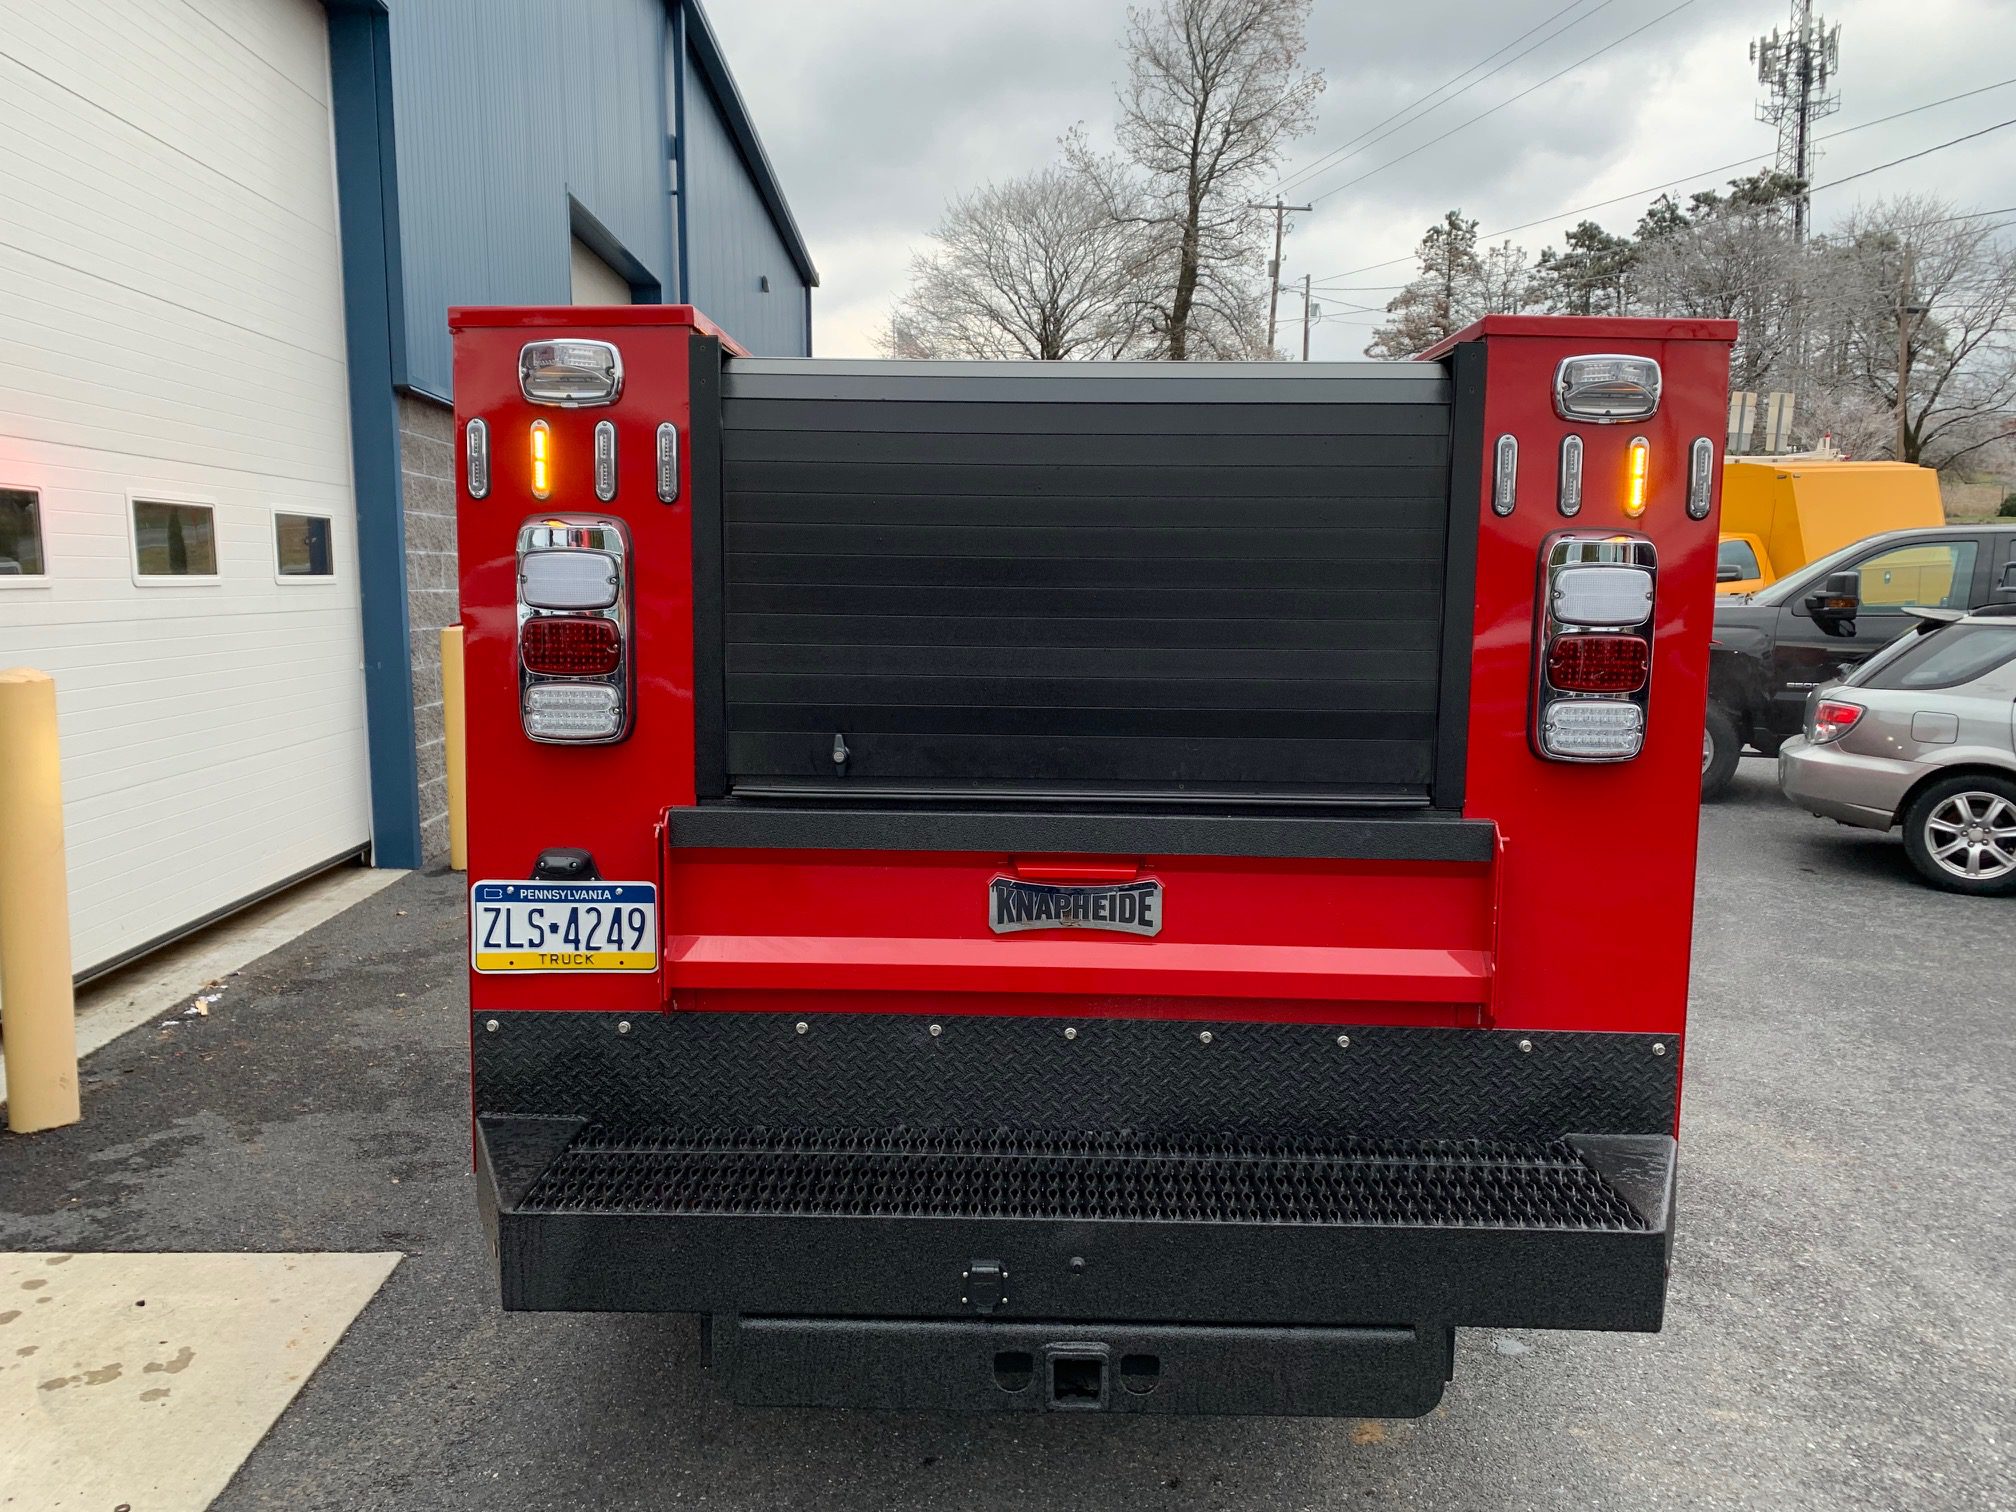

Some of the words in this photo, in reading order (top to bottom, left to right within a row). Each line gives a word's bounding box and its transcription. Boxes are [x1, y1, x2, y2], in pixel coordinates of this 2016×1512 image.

[520, 889, 611, 900] PENNSYLVANIA
[997, 886, 1154, 927] KNAPHEIDE
[538, 953, 594, 965] TRUCK
